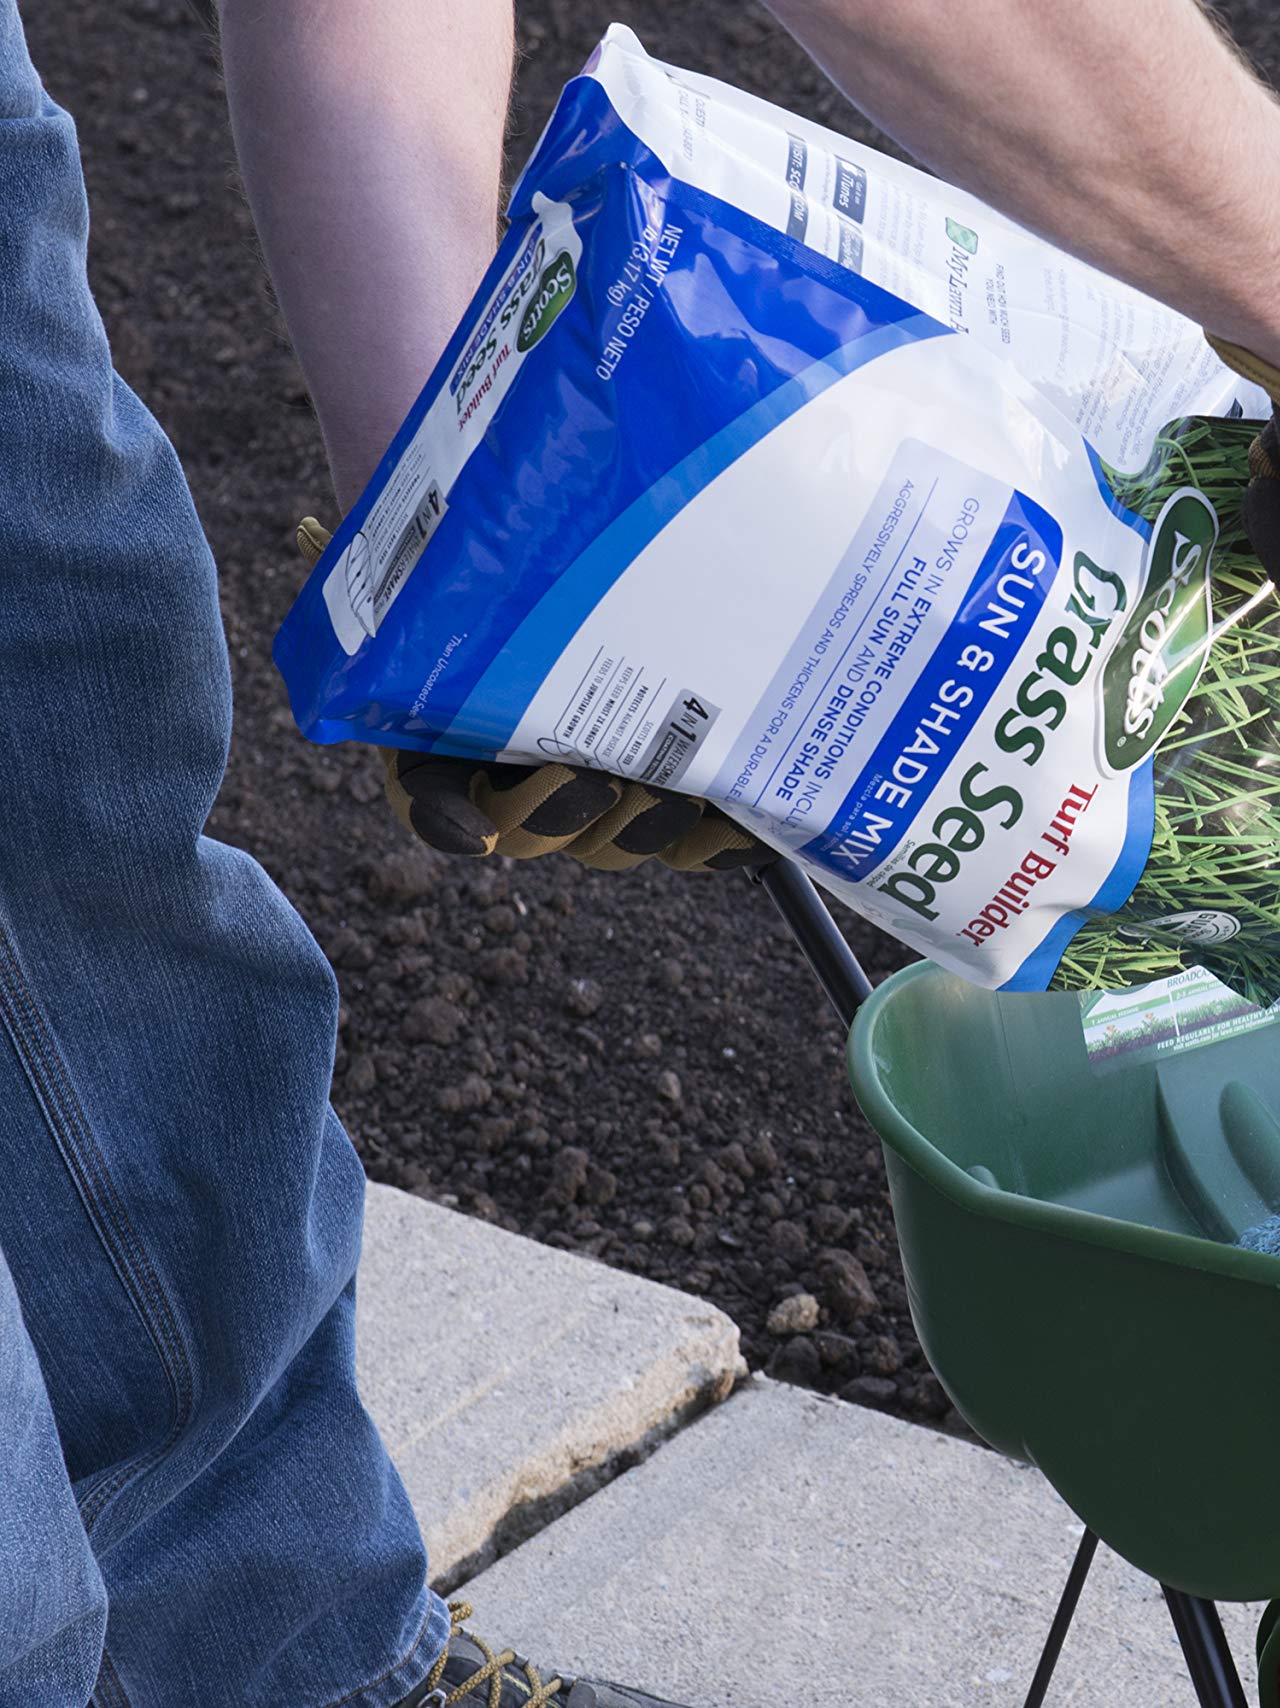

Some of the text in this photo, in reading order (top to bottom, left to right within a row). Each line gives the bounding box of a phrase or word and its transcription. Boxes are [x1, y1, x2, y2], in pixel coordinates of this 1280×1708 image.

[837, 172, 853, 207] iTunes
[655, 222, 683, 258] NET
[642, 254, 670, 287] WT
[945, 246, 970, 277] My
[522, 261, 571, 341] Scotts
[602, 277, 631, 308] kg)
[948, 274, 967, 317] Lawn
[455, 238, 547, 415] Grass Seed
[474, 292, 505, 347] SHADE
[615, 293, 650, 339] PESO
[457, 347, 474, 378] MIX
[592, 335, 627, 381] NETO
[457, 343, 511, 432] Turf Builder
[427, 489, 441, 515] 4
[934, 495, 981, 573] GROWS
[923, 573, 944, 595] IN
[441, 633, 462, 659] Than
[729, 478, 915, 797] AGGRESSIVELY SPREADS AND THICKENS FOR A DURABLE
[873, 596, 932, 680] EXTREME
[1122, 530, 1204, 739] Scotts
[417, 656, 449, 702] Uncoated
[609, 683, 623, 699] SEED
[618, 665, 634, 685] KEEPS
[775, 556, 927, 801] FULL SUN AND DENSE SHADE
[562, 656, 613, 739] FEEDS TO JUMPSTART GROWTH
[600, 697, 615, 716] MOIST
[682, 697, 708, 720] 4
[829, 539, 1049, 865] SUN & SHADE MIX
[595, 715, 605, 724] 2X
[601, 684, 648, 758] PROTECTS AGAINST DISEASE
[668, 721, 698, 742] 1
[679, 711, 698, 728] IN
[812, 678, 883, 781] CONDITIONS
[876, 550, 1124, 921] Grass Seed
[622, 719, 653, 766] SCOTTS BEST SEED
[859, 772, 882, 802] Mezcla
[839, 820, 852, 834] sol
[847, 799, 863, 820] para
[889, 838, 916, 866] Semillas
[955, 782, 1098, 948] Turf Builder
[1165, 966, 1210, 988] BROADCA
[1157, 1038, 1174, 1049] FEED
[1176, 1025, 1214, 1043] REGULARLY
[1217, 1020, 1230, 1030] FOR
[1233, 1010, 1263, 1025] HEALTHY
